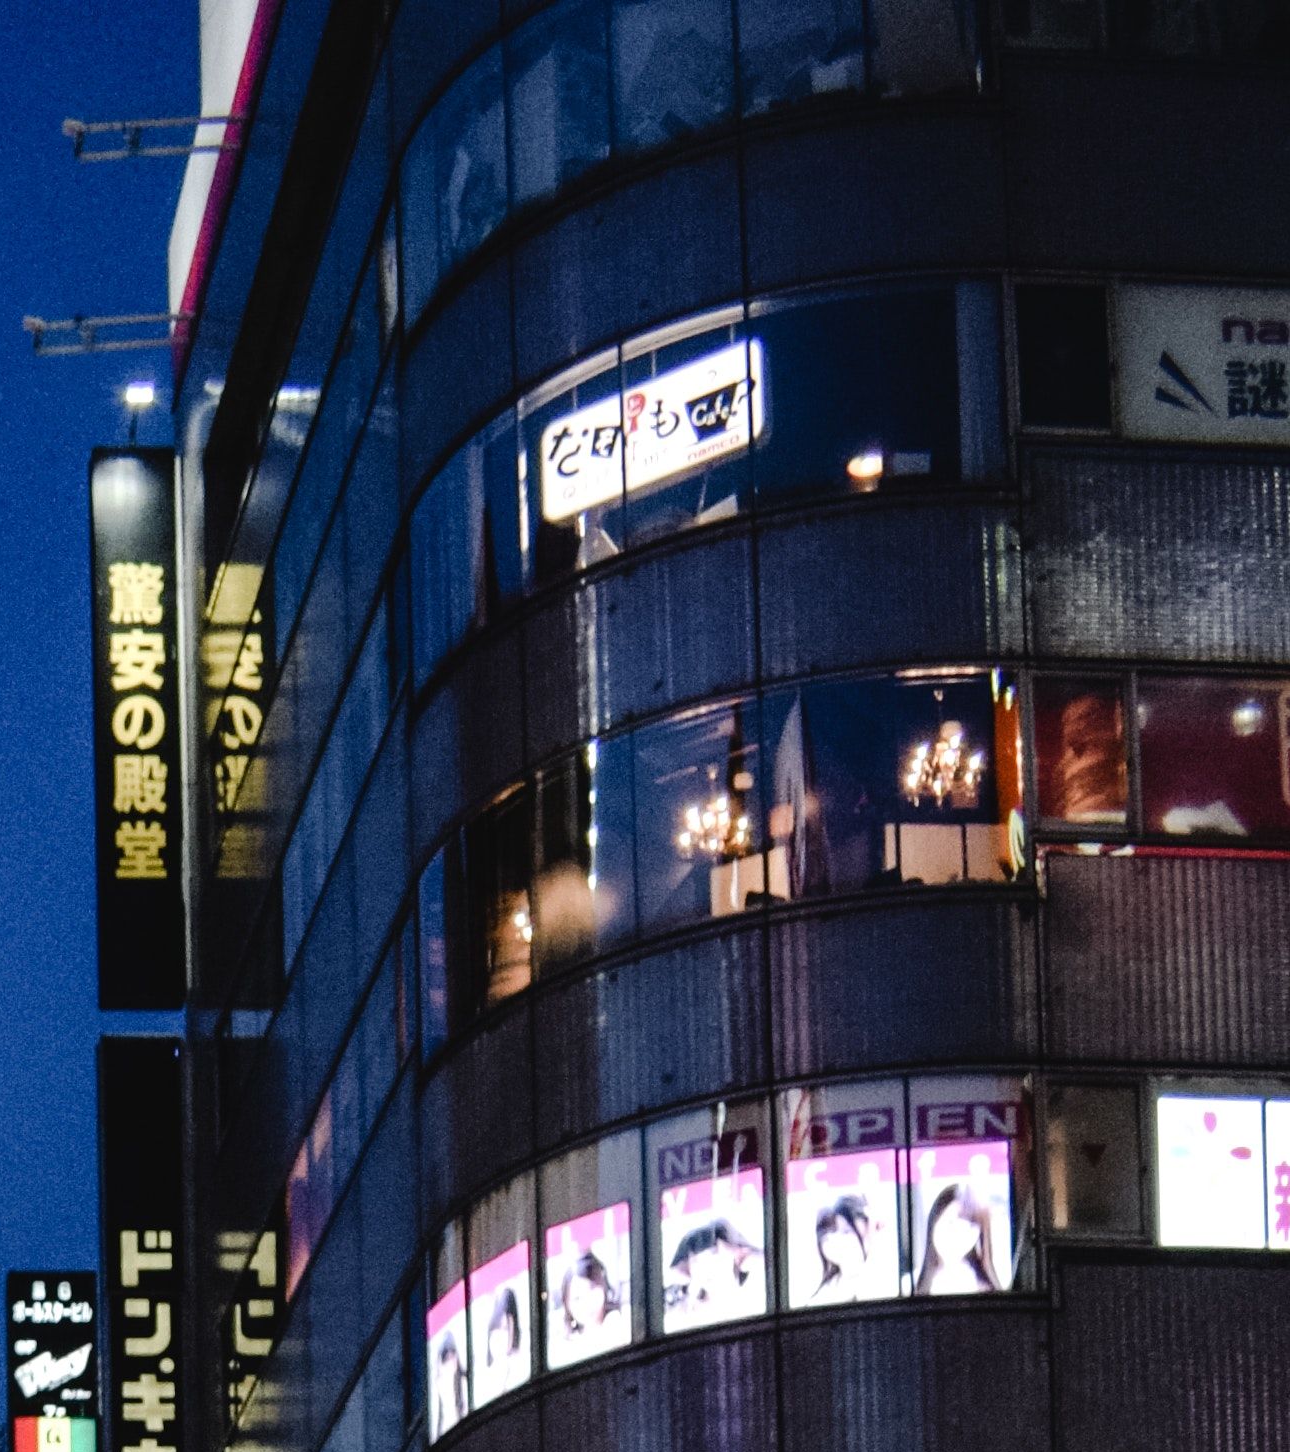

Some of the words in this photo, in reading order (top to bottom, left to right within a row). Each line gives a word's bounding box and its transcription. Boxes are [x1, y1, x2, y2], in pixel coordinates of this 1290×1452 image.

[108, 562, 167, 879] 驚安の殿堂
